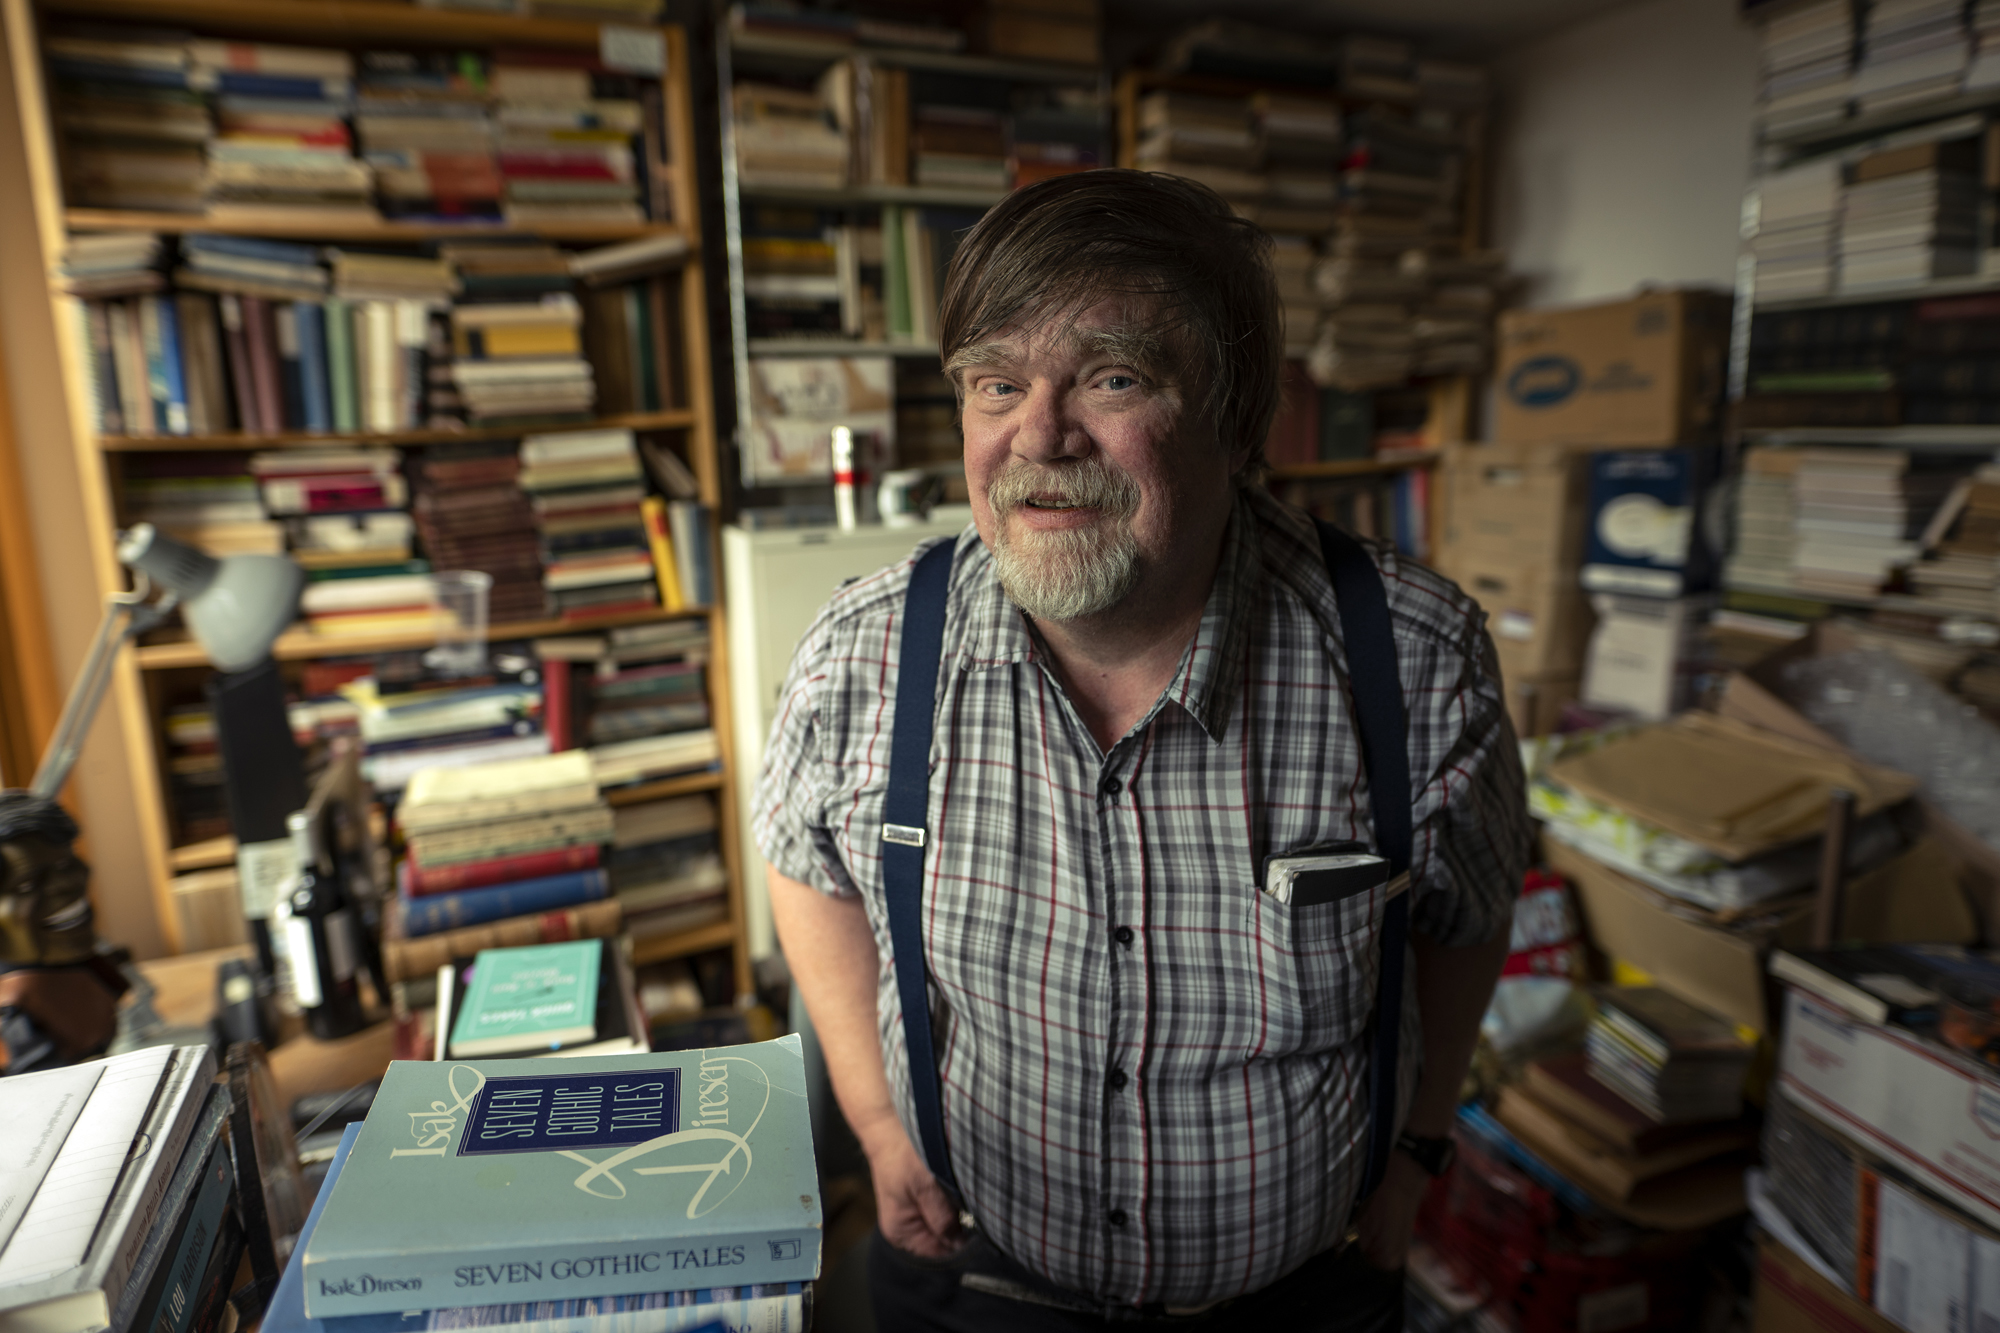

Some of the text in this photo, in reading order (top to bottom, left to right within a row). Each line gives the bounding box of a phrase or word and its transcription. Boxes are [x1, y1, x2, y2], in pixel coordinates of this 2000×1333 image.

[480, 1089, 543, 1140] SEVEN
[545, 1086, 604, 1136] GOTHIC
[609, 1082, 664, 1132] TALES
[389, 1049, 770, 1220] Isak Dinesen
[169, 1218, 208, 1324] LOU HARRISON
[453, 1244, 745, 1288] SEVEN GOTHIC TALES
